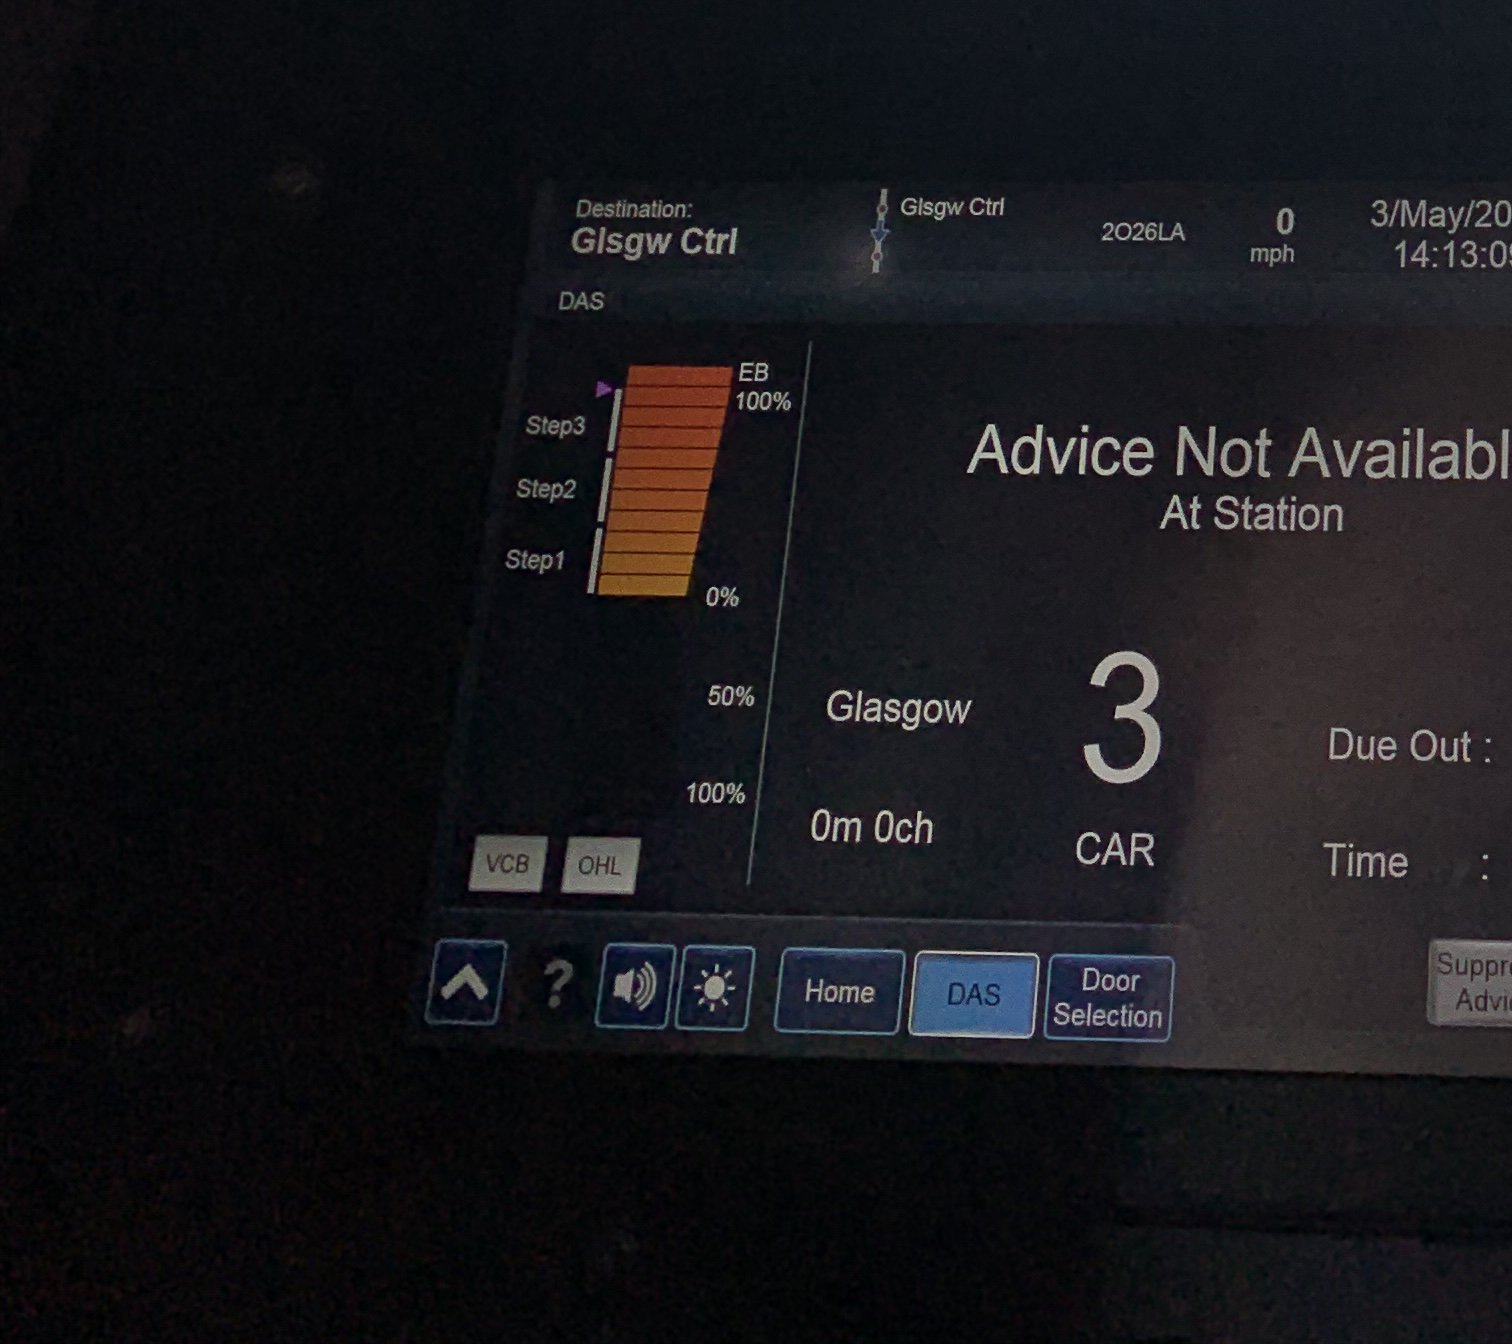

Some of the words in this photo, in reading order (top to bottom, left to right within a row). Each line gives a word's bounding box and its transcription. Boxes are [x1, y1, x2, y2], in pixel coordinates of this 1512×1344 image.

[575, 198, 693, 219] Destination:
[900, 197, 966, 223] Glsgw
[968, 197, 1005, 216] Ctrl
[1276, 207, 1295, 235] 0
[571, 226, 674, 262] Glsgw
[680, 226, 738, 255] Ctrl
[1250, 243, 1295, 268] mph
[558, 290, 605, 311] DAS
[738, 361, 770, 382] EB
[736, 390, 792, 411] 100%
[525, 414, 586, 440] Step3
[966, 423, 1155, 477] Advice
[1176, 425, 1273, 479] Not
[516, 478, 577, 505] Step2
[1159, 494, 1202, 530] At
[1213, 494, 1344, 532] Station
[504, 548, 565, 575] Step1
[705, 585, 740, 607] 0%
[707, 684, 756, 707] 50%
[826, 689, 973, 732] Glasgow
[1083, 650, 1162, 785] 3
[1328, 727, 1398, 761] Due
[1409, 728, 1472, 763] Out
[686, 781, 747, 805] 100%
[811, 808, 862, 843] 0m
[874, 809, 934, 844] 0ch
[1075, 831, 1155, 867] CAR
[1322, 842, 1409, 878] Time
[485, 852, 530, 874] VCB
[577, 854, 621, 876] OHL
[804, 978, 876, 1004] Home
[1082, 966, 1141, 992] Door
[947, 981, 1001, 1007] DAS
[1053, 1001, 1163, 1029] Selection
